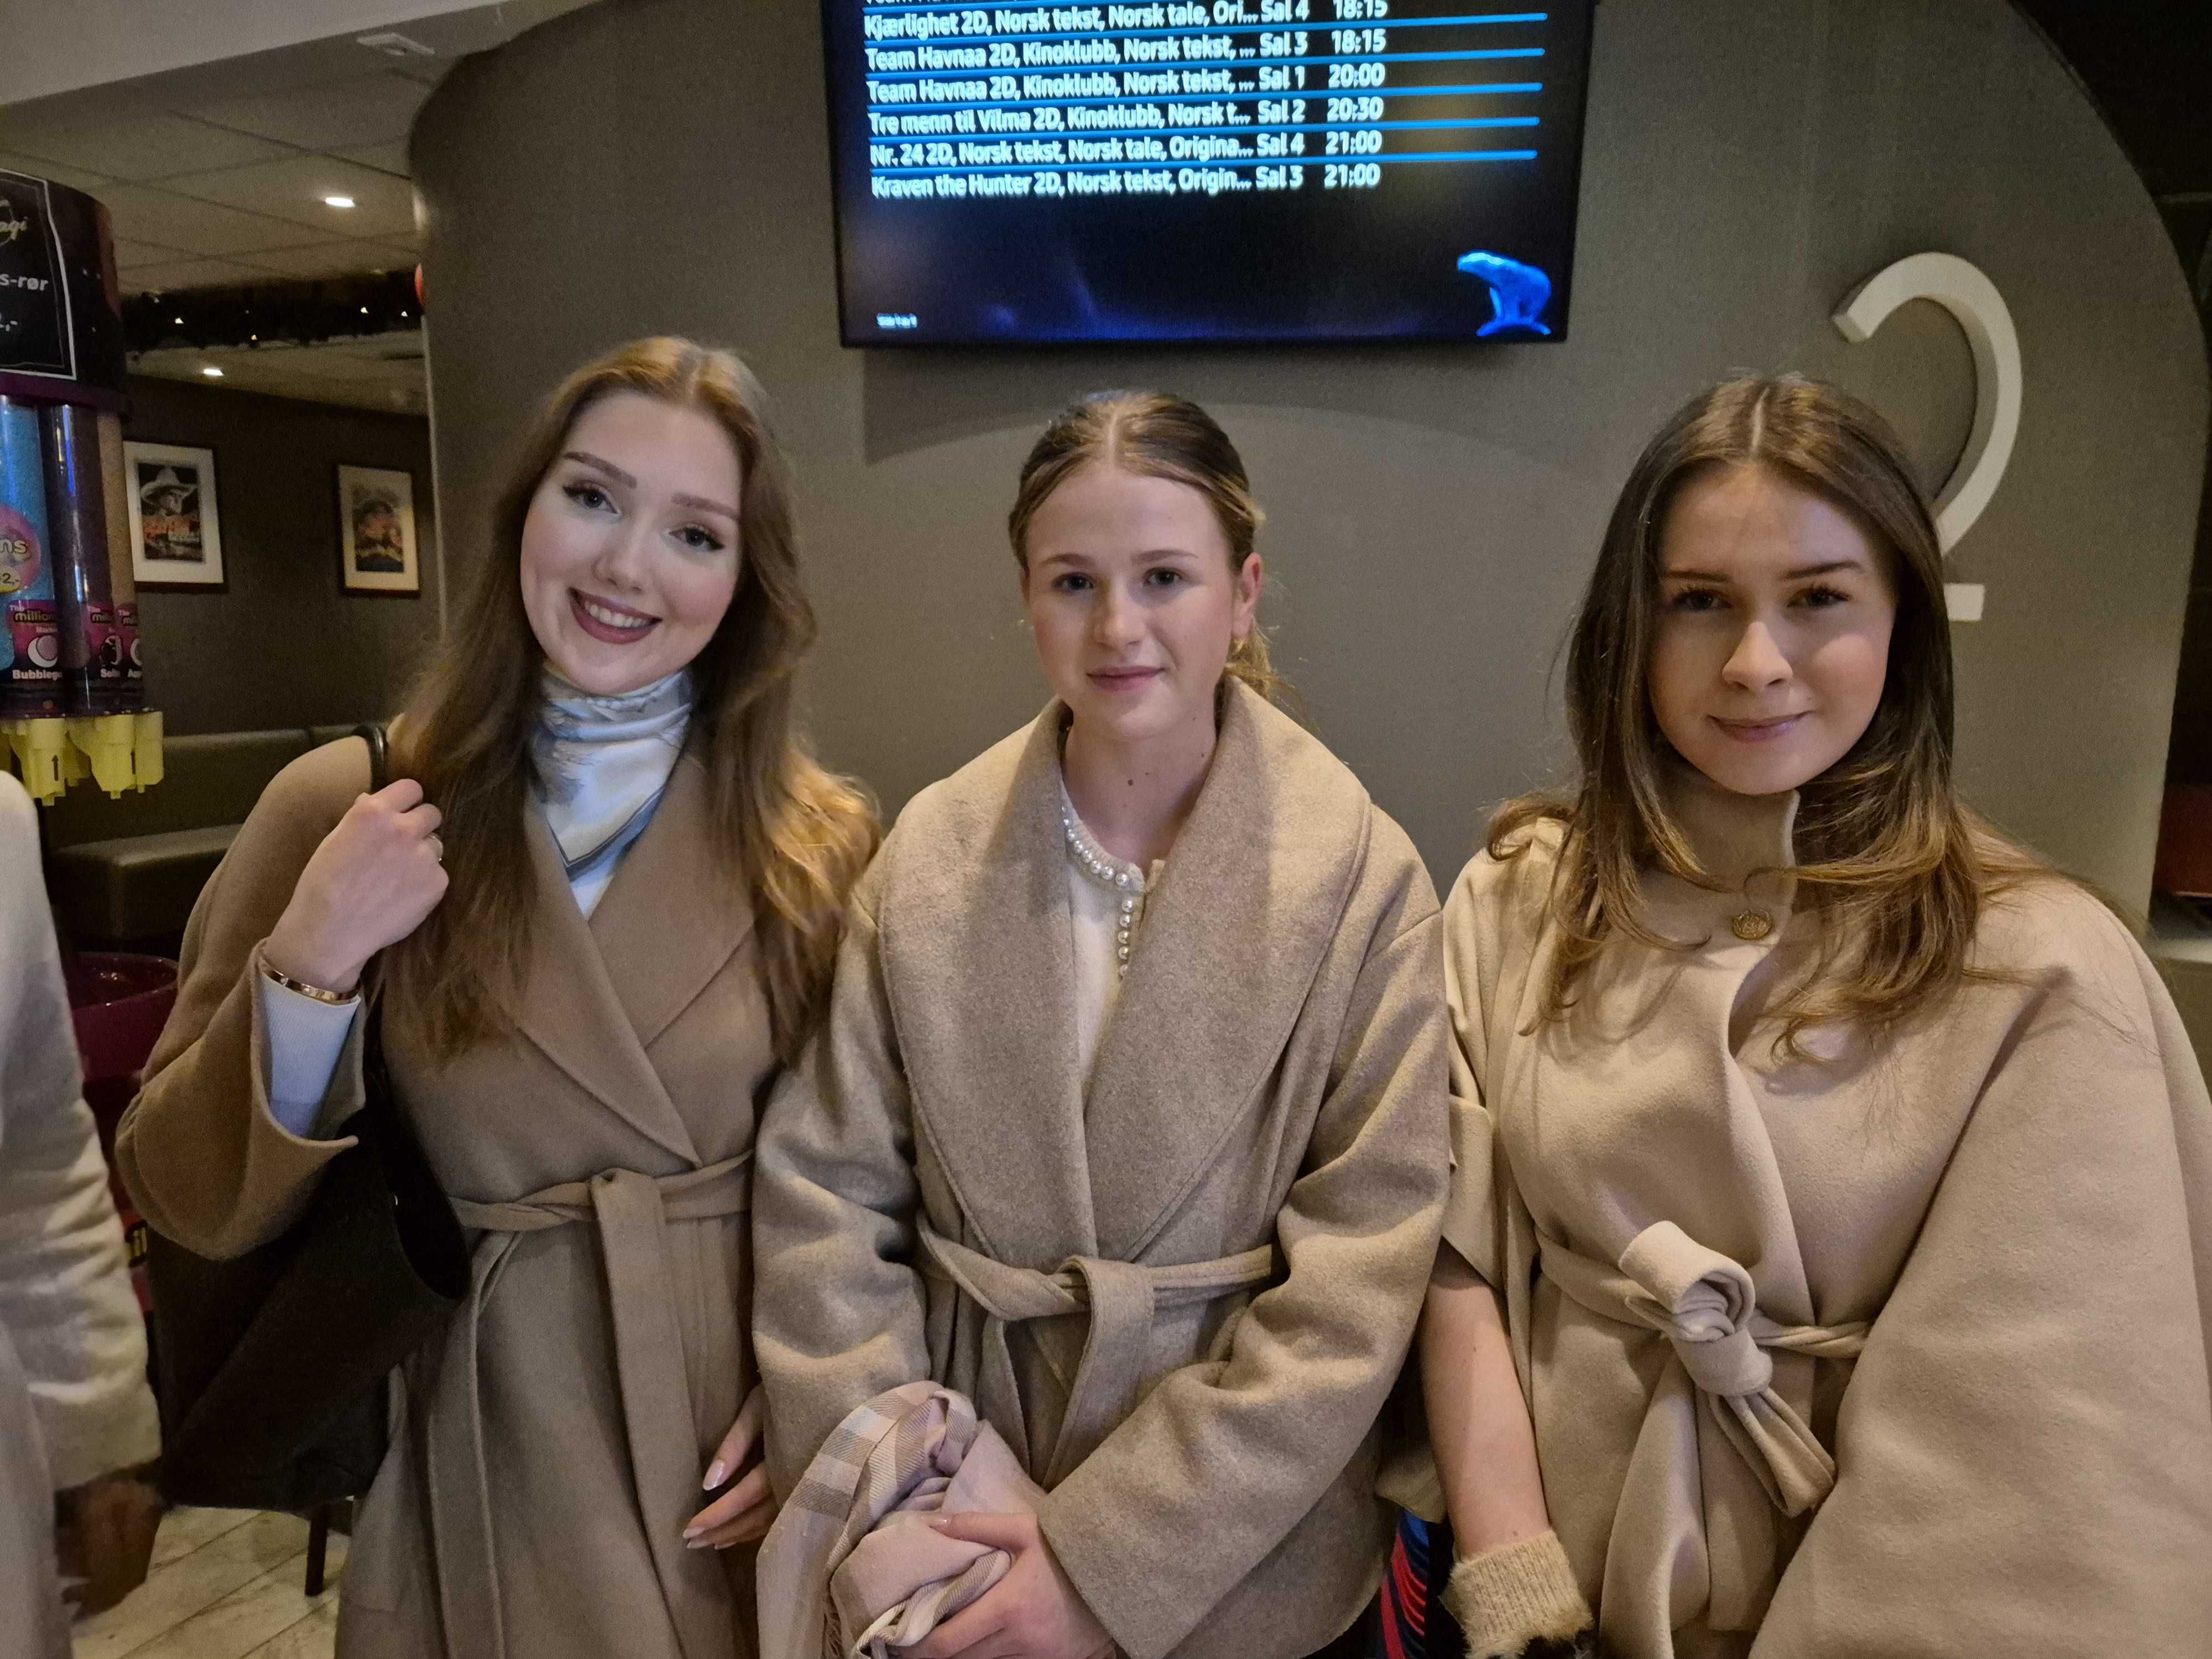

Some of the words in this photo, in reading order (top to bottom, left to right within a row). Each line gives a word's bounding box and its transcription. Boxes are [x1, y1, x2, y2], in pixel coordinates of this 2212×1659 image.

[864, 12, 959, 41] Kjærlighet
[961, 11, 992, 35] 2D,
[995, 8, 1050, 33] Norsk
[1052, 7, 1105, 31] tekst,
[1109, 3, 1165, 28] Norsk
[1167, 2, 1210, 27] tale,
[1261, 0, 1292, 22] Sal
[1296, 0, 1310, 20] 4
[1333, 0, 1387, 19] 18:15
[865, 49, 915, 71] Team
[918, 46, 986, 69] Havnaa
[989, 43, 1020, 68] 2D,
[1023, 39, 1120, 65] Kinoklubb,
[1124, 36, 1180, 62] Norsk
[1182, 34, 1236, 60] tekst,
[1260, 32, 1291, 56] Sal
[1295, 32, 1308, 55] 3
[1332, 29, 1386, 54] 18:15
[866, 81, 916, 103] Team
[920, 80, 987, 102] Havnaa
[989, 76, 1021, 101] 2D,
[1024, 72, 1120, 98] Kinoklubb,
[1124, 70, 1180, 95] Norsk
[1182, 69, 1235, 94] tekst,
[1259, 66, 1290, 90] Sal
[1295, 66, 1305, 89] 1
[1328, 63, 1385, 87] 20:00
[868, 113, 899, 135] Tre
[901, 114, 952, 134] menn
[954, 109, 976, 132] til
[977, 109, 1031, 132] Vilma
[1034, 107, 1065, 132] 2D,
[1068, 103, 1165, 129] Kinoklubb,
[1168, 101, 1224, 126] Norsk
[1258, 99, 1289, 123] Sal
[1292, 100, 1305, 122] 2
[1327, 97, 1384, 121] 20:30
[870, 145, 898, 166] Nr.
[900, 144, 924, 165] 24
[926, 143, 957, 166] 2D,
[959, 141, 1013, 164] Norsk
[1014, 140, 1066, 164] tekst,
[1068, 138, 1123, 161] Norsk
[1125, 137, 1167, 161] tale,
[1257, 132, 1288, 156] Sal
[1291, 133, 1305, 155] 4
[1326, 131, 1382, 154] 21:00
[872, 176, 933, 198] Kraven
[935, 174, 967, 196] the
[969, 174, 1032, 196] Hunter
[1034, 172, 1065, 197] 2D,
[1068, 170, 1122, 194] Norsk
[1124, 169, 1176, 195] tekst,
[1256, 165, 1287, 189] Sal
[1290, 165, 1303, 189] 3
[1324, 163, 1381, 187] 21:00
